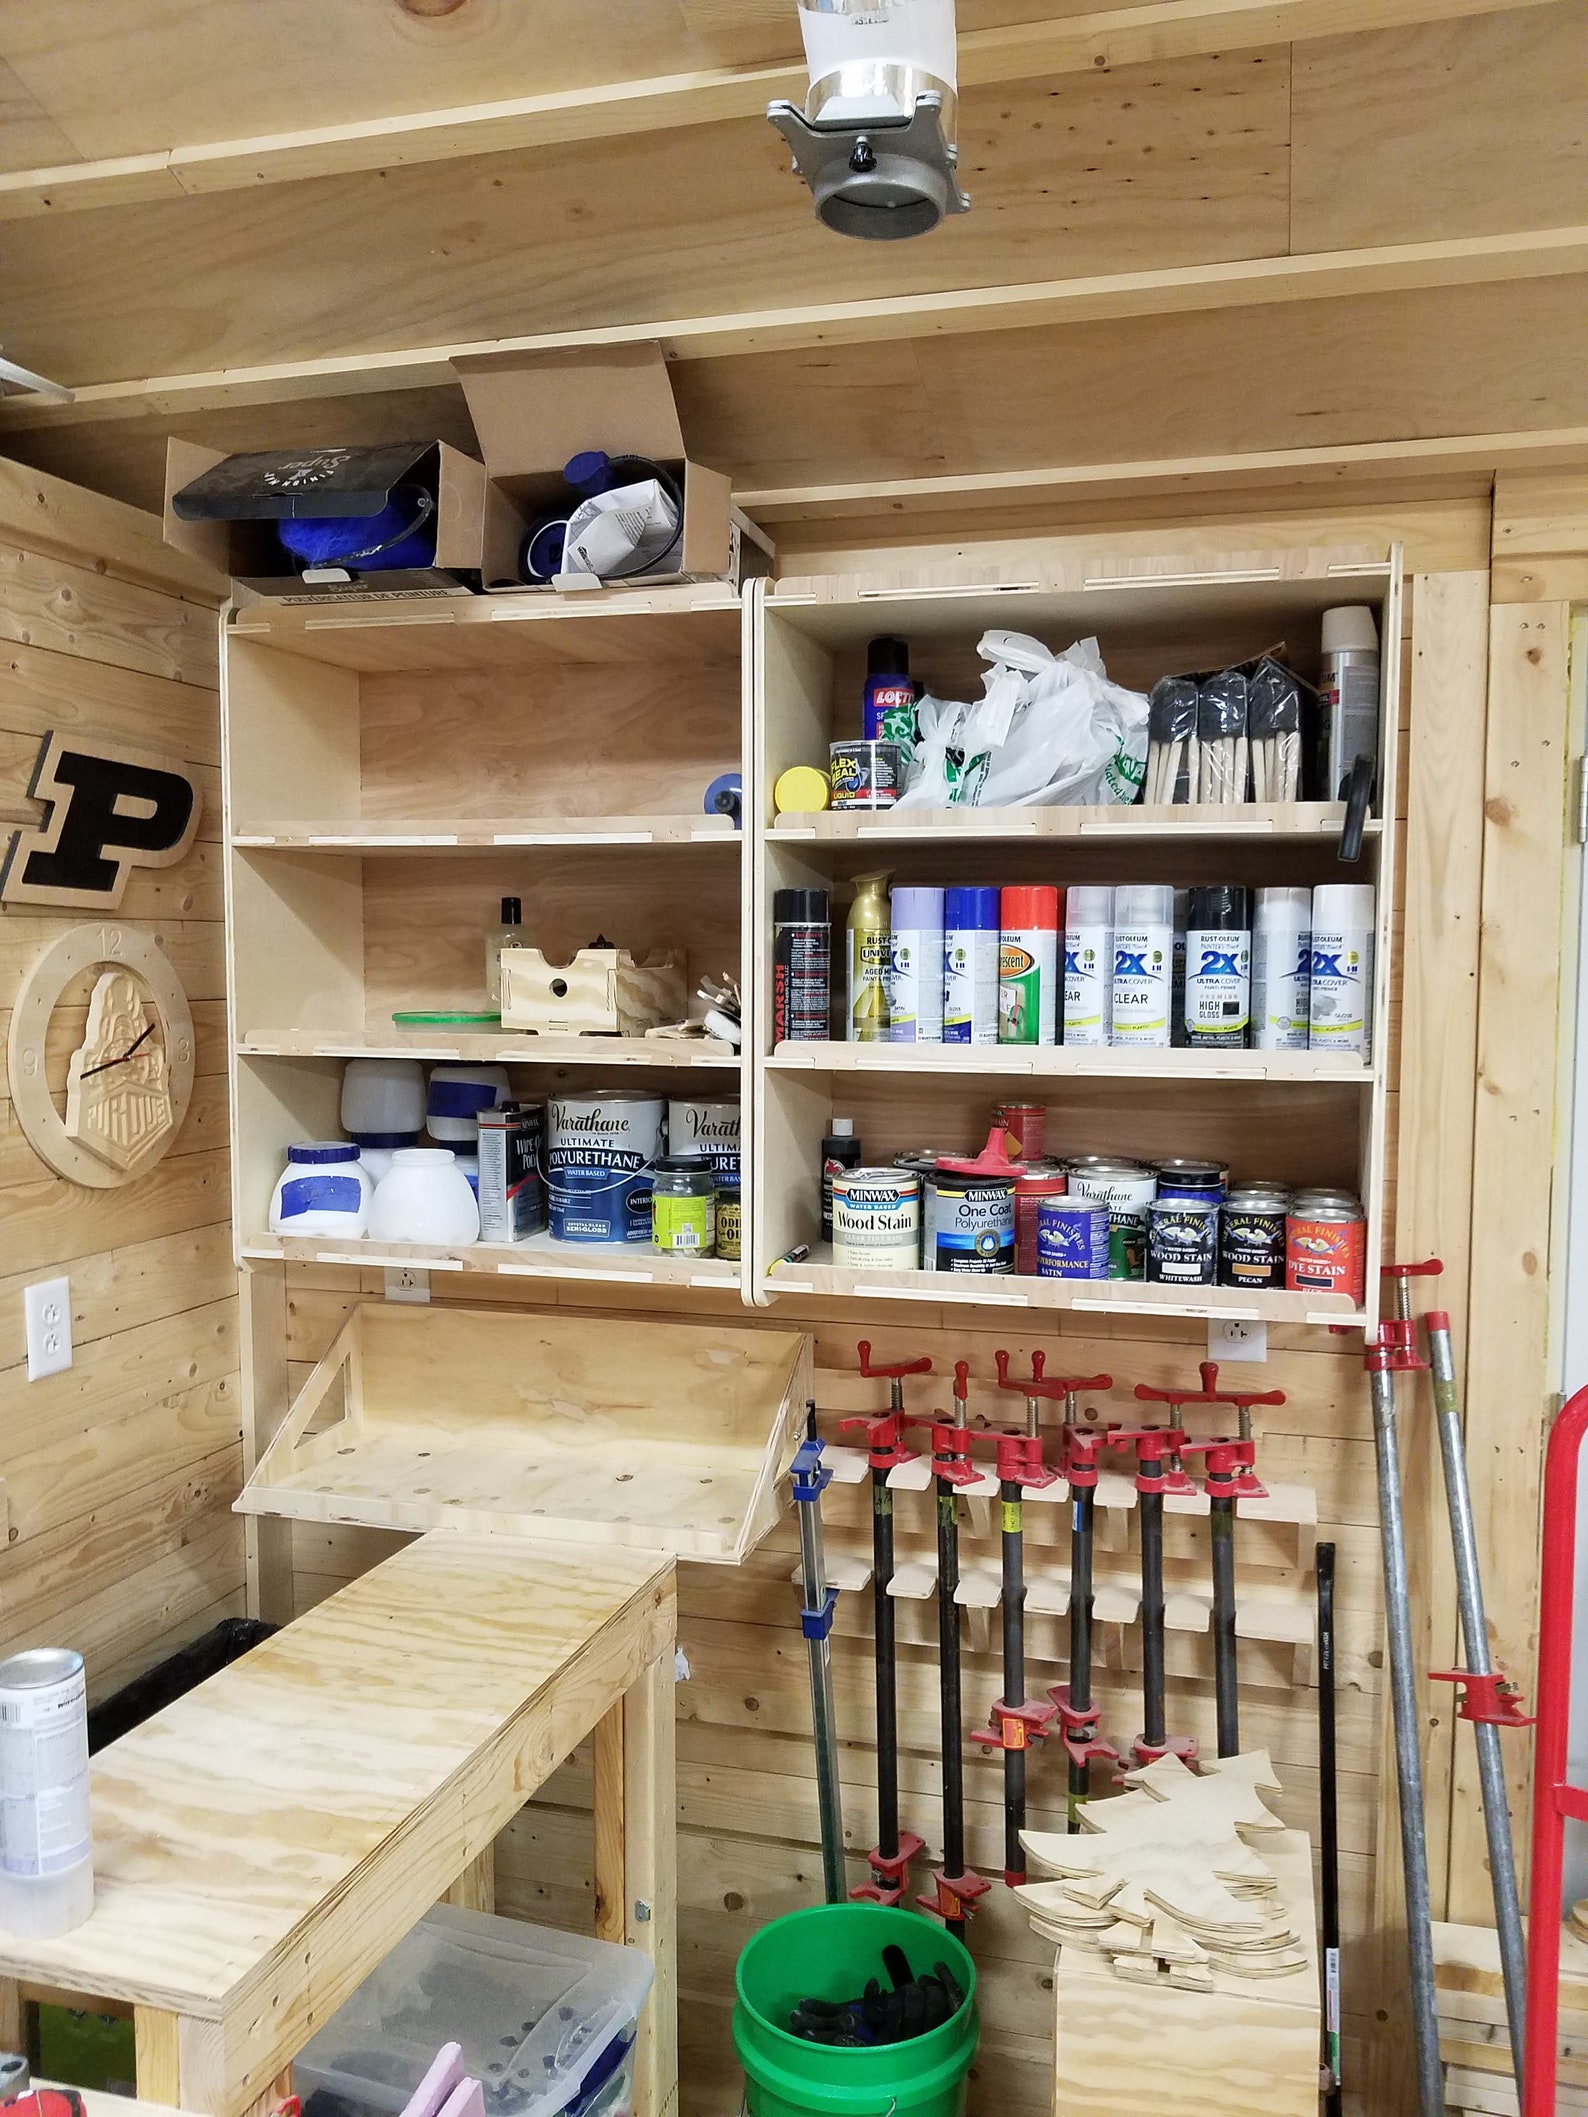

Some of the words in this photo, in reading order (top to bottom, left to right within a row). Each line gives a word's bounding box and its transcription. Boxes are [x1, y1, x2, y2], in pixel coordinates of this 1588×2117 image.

[876, 690, 915, 705] LOCTI
[97, 926, 123, 957] 12
[1114, 951, 1148, 975] 2X
[1200, 950, 1240, 975] 2X
[1065, 991, 1081, 1001] EAR
[1114, 993, 1149, 1004] CLEAR
[775, 964, 785, 1043] MARSH
[1199, 1000, 1220, 1011] HIGH
[1199, 1011, 1220, 1019] GLOSS
[177, 1037, 191, 1063] 3
[23, 1047, 39, 1077] 9
[551, 1103, 630, 1132] Varathane
[560, 1137, 615, 1148] ULTIMATE
[699, 1143, 741, 1153] ULTIM
[549, 1150, 641, 1170] POLYURETHANE
[566, 1169, 585, 1177] WATER
[849, 1189, 898, 1201] MINWAX
[968, 1189, 1006, 1202] MINWAX
[1077, 1181, 1133, 1201] Varathane
[630, 1196, 653, 1205] INTERIO
[958, 1204, 987, 1217] One
[989, 1203, 1012, 1216] Coat
[837, 1211, 875, 1230] Wood
[877, 1213, 912, 1231] Stain
[1150, 1249, 1181, 1262] WOOD
[1183, 1252, 1213, 1262] STAIN
[1222, 1250, 1251, 1263] WOOD
[1253, 1255, 1285, 1264] STAIN
[1288, 1259, 1305, 1273] DYE
[1307, 1264, 1346, 1276] STAIN
[1159, 1273, 1203, 1282] WHITEWASH
[1238, 1276, 1263, 1284] PECAN
